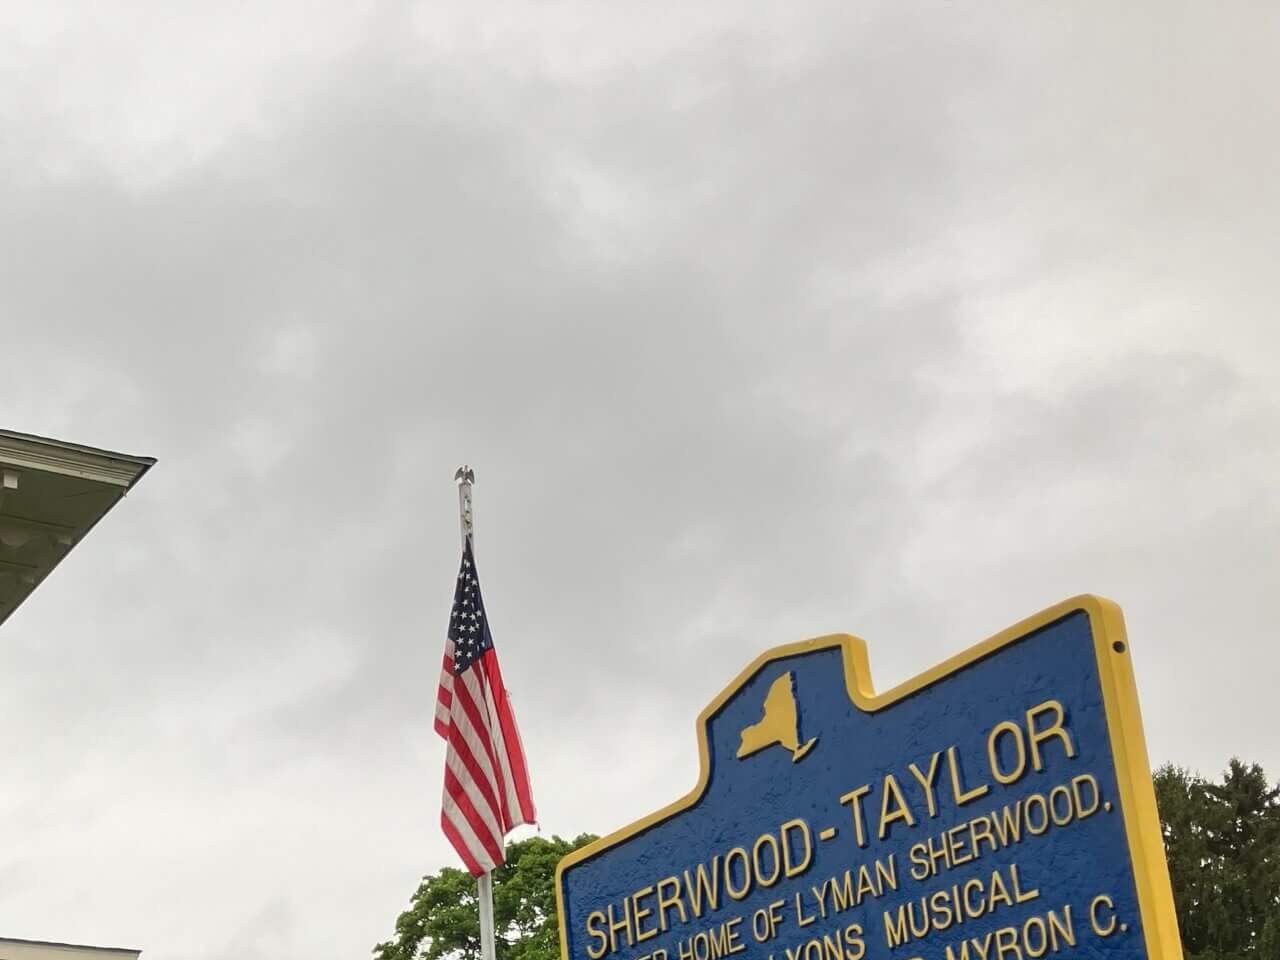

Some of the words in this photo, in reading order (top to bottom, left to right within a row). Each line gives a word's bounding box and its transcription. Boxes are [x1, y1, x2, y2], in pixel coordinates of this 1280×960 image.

[752, 899, 785, 942] OF
[795, 854, 897, 927] LYMAN
[883, 863, 1040, 949] MUSICAL
[1089, 894, 1128, 937] C.
